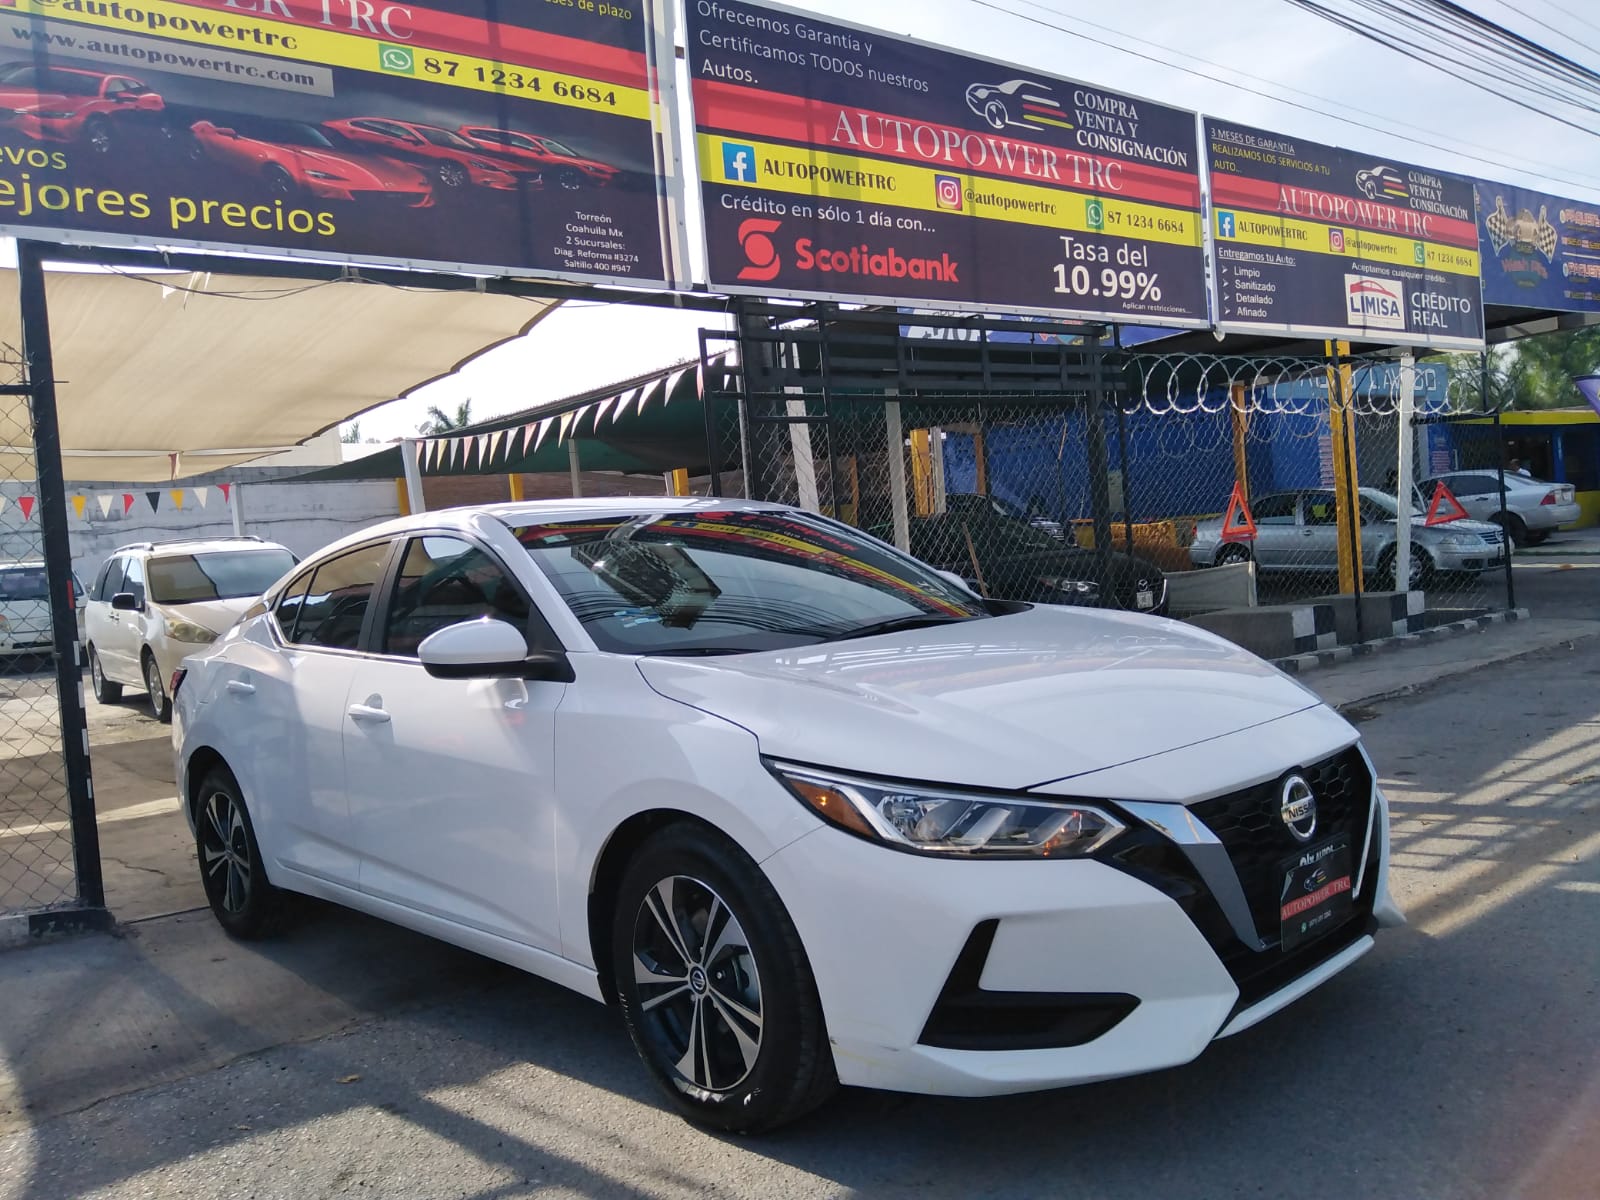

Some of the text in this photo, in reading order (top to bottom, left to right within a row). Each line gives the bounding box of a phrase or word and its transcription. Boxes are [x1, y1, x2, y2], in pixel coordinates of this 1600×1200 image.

[598, 3, 632, 20] plazo
[32, 0, 298, 50] autopowertrc
[697, 1, 873, 57] Ofrecemos Garantía y
[12, 27, 314, 86] www.autopowertrc.com
[700, 29, 929, 92] Certificamos TODOS nuestros
[424, 57, 616, 106] 87 1234 6684
[702, 58, 759, 84] Autos.
[1074, 90, 1139, 120] COMPRA
[1075, 110, 1139, 139] VENTA Y
[832, 110, 1123, 191] AUTOPOWER TRC
[1077, 130, 1188, 167] CONSIGNACIÓN
[1217, 129, 1244, 143] MESES
[1245, 136, 1256, 147] DE
[1257, 138, 1296, 154] GARANTÍA
[1212, 143, 1261, 161] REALIZAMOS
[1262, 153, 1277, 165] LOS
[1278, 156, 1313, 173] SERVICIOS
[1320, 165, 1331, 176] TU
[763, 158, 897, 192] AUTOPOWERTRC
[1408, 170, 1443, 190] COMPRA
[964, 187, 1057, 216] @autopowertrc
[1409, 183, 1443, 202] VENTA Y
[169, 196, 336, 236] precios
[575, 211, 612, 223] Torreón
[721, 193, 936, 233] Crédito en sólo 1 día con...
[1277, 186, 1433, 238] AUTOPOWER TRC
[1410, 197, 1469, 220] CONSIGNACIÓN
[566, 223, 624, 237] Coahuila Mx
[1107, 210, 1184, 234] 87 1234 6684
[1239, 221, 1308, 241] AUTOPOWERTRC
[566, 236, 626, 250] 2 Sucursales:
[1059, 235, 1148, 267] Tasa del
[1345, 236, 1398, 255] @autopowertrc
[564, 259, 631, 273] Saltillo 400 #947
[577, 249, 612, 261] Reforma
[614, 254, 639, 263] #3274
[795, 238, 960, 283] Scotiabank
[1218, 247, 1296, 265] Entregamos tu Auto:
[1427, 250, 1435, 260] 87
[1438, 253, 1454, 265] 1234
[1053, 263, 1162, 302] 10.99%
[1234, 266, 1261, 278] Limpio
[1352, 262, 1390, 276] Aceptamos
[1391, 269, 1424, 281] cualquier
[1235, 279, 1276, 292] Sanitizado
[1122, 301, 1146, 312] Aplican
[1236, 293, 1273, 305] Detallado
[1350, 295, 1400, 317] LIMISA
[1411, 291, 1471, 314] CRÉDITO
[1237, 306, 1267, 318] Afinado
[1413, 310, 1448, 328] REAL
